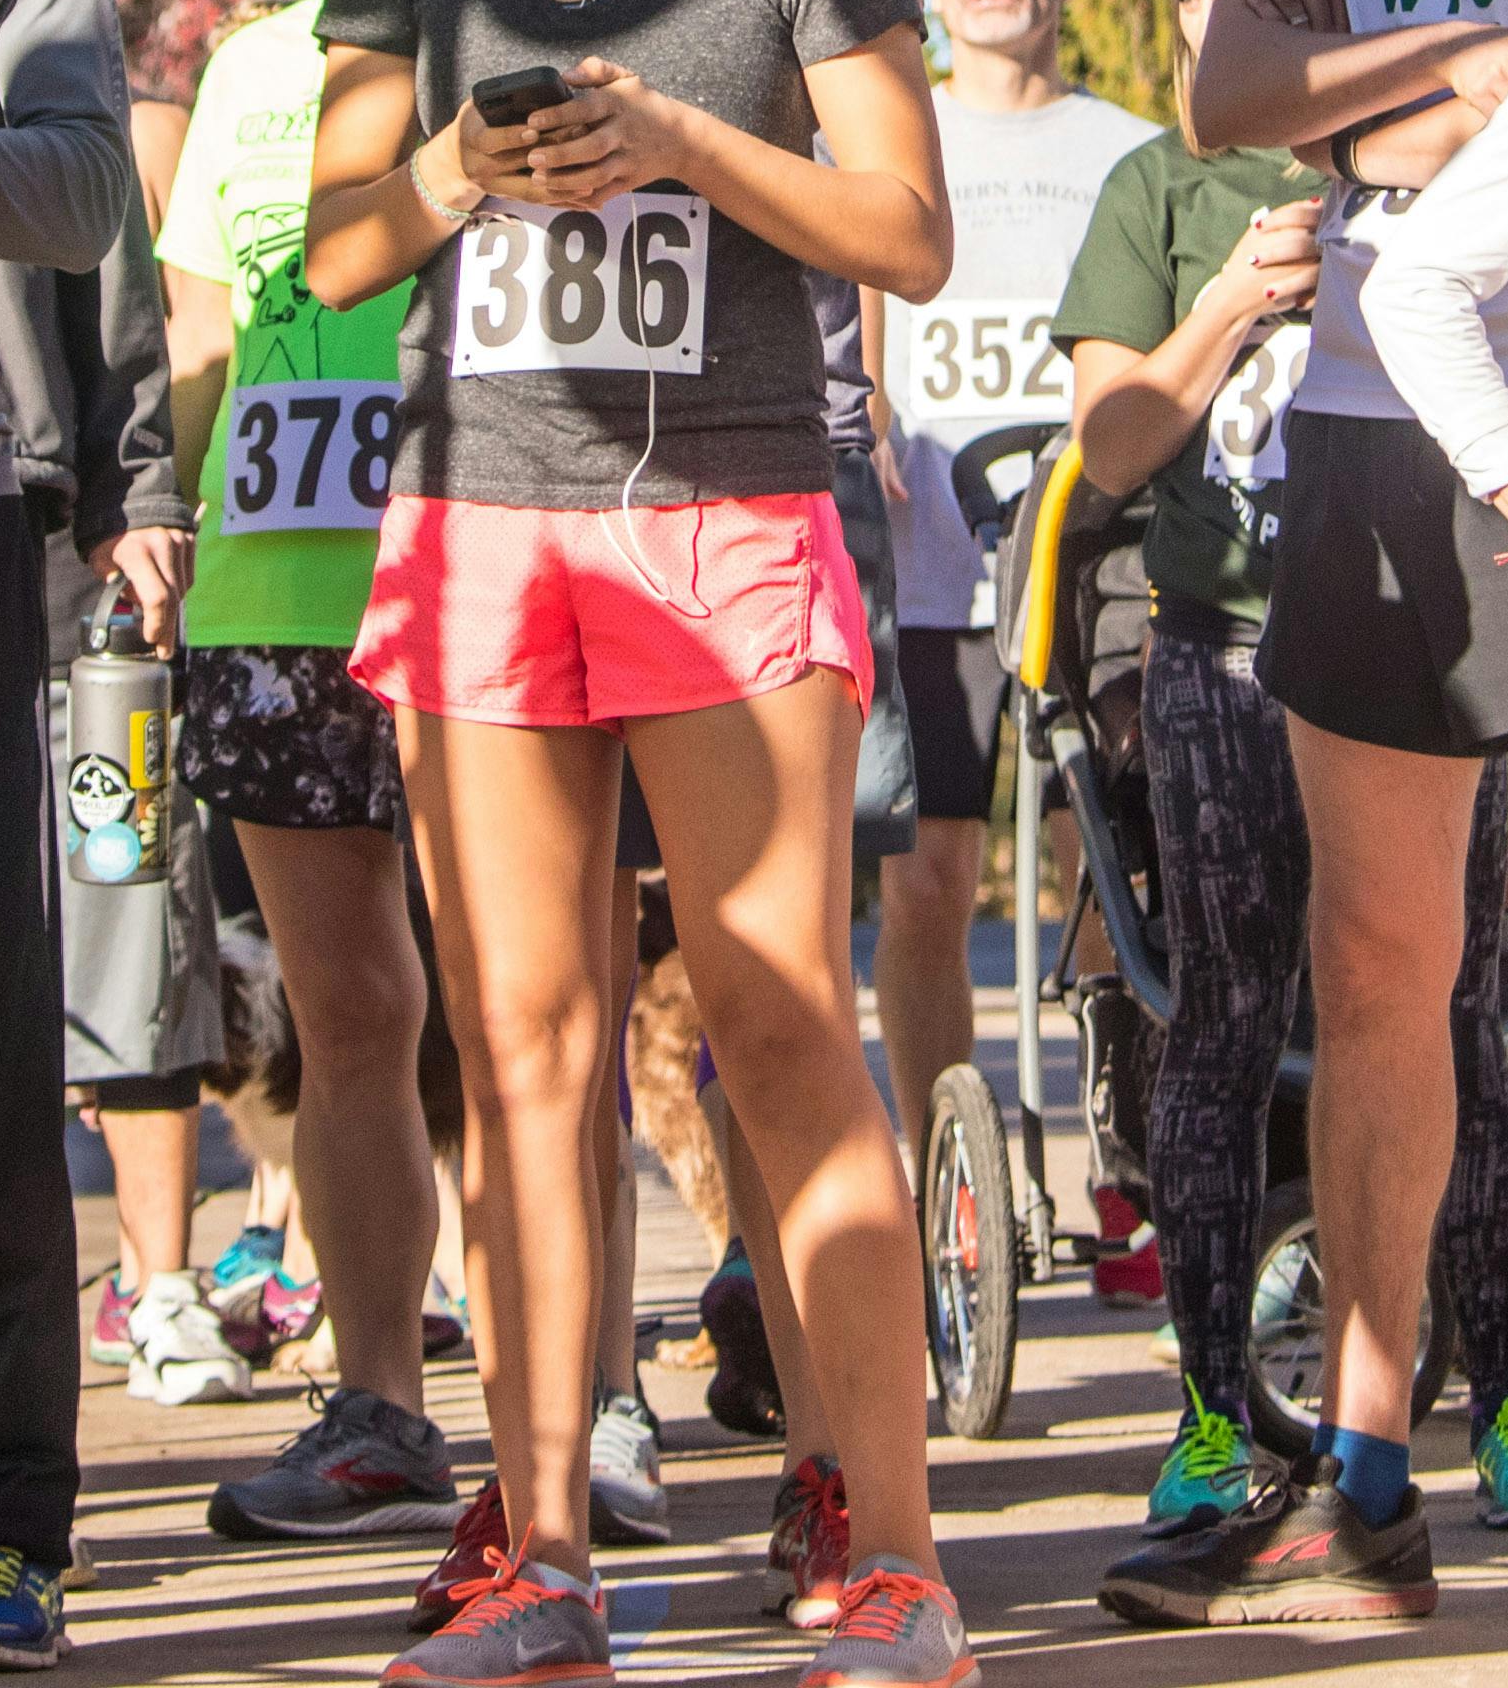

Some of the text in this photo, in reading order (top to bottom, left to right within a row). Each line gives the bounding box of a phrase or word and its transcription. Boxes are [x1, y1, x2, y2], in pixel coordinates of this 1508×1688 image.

[471, 209, 692, 349] 386
[922, 315, 1064, 401] 352
[233, 395, 399, 513] 378
